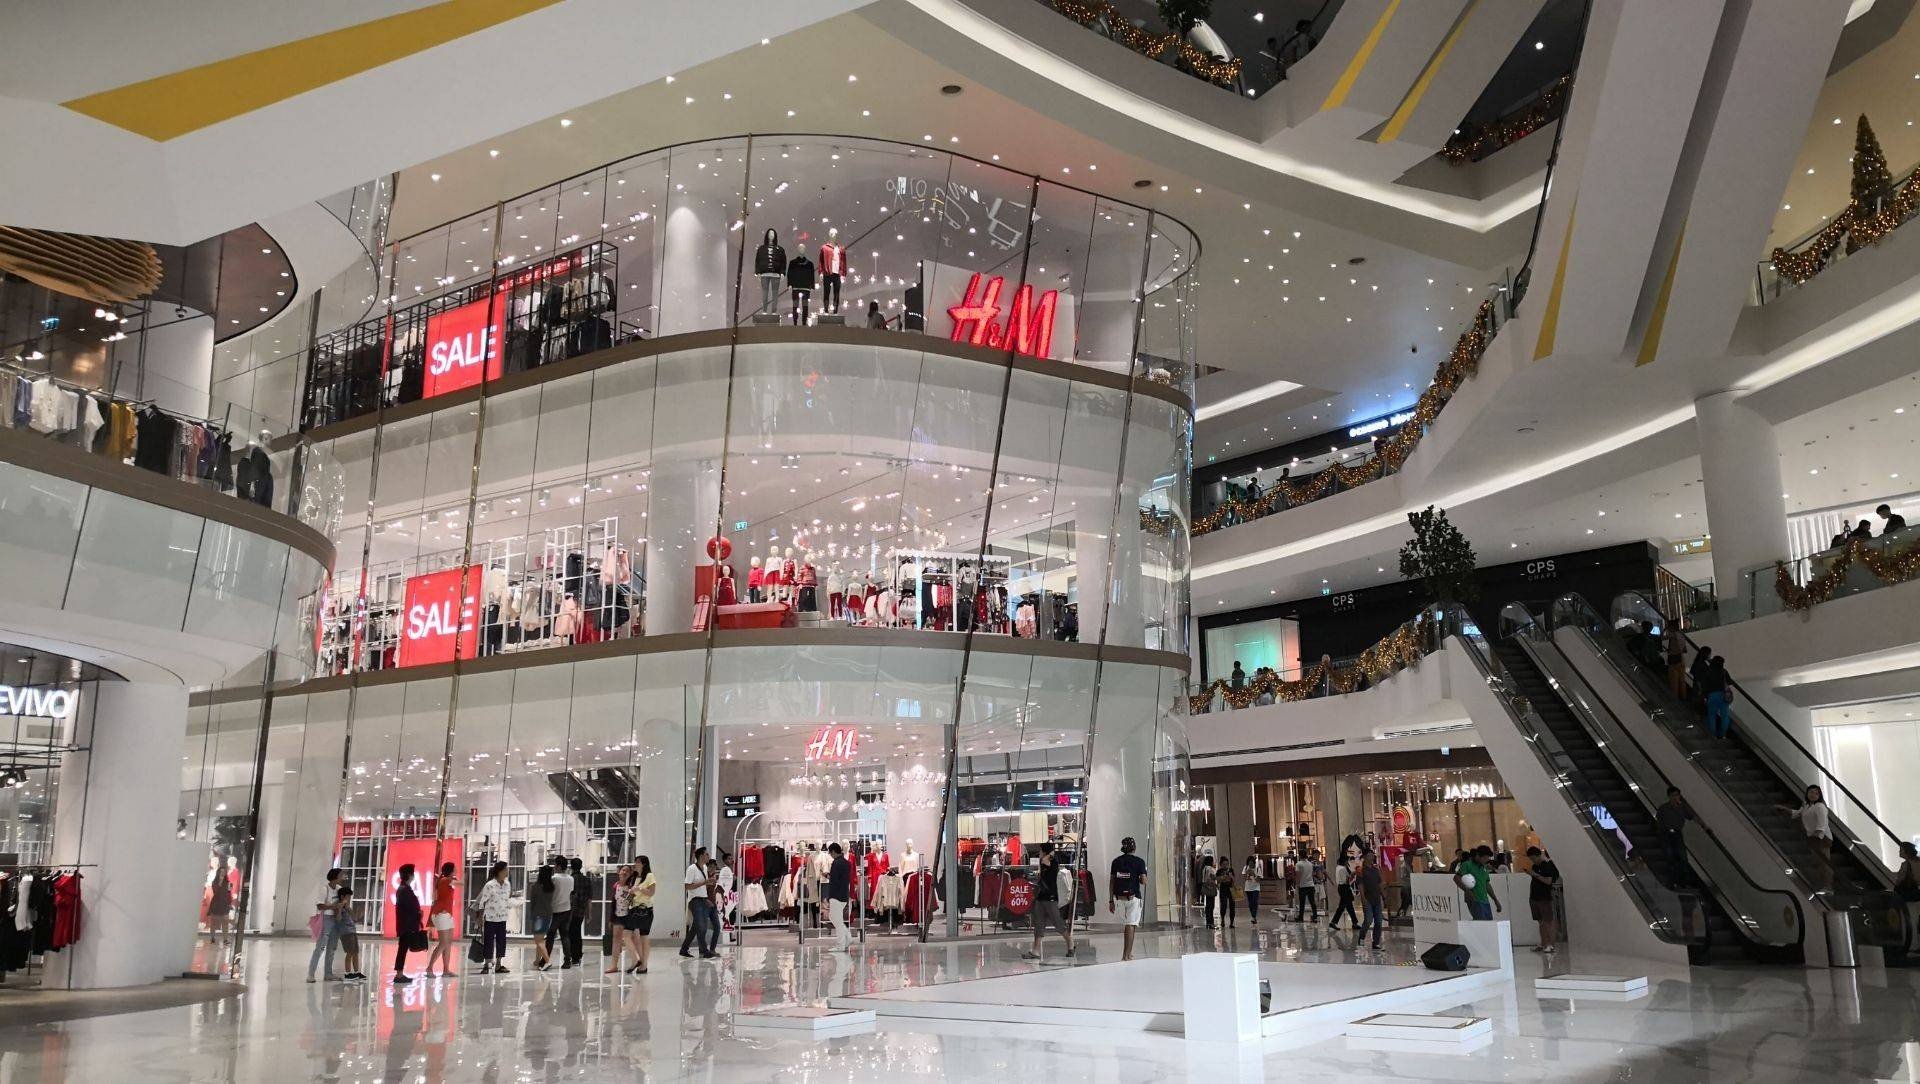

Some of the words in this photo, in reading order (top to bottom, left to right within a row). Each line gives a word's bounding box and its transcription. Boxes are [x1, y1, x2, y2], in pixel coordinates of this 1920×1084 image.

[947, 272, 1057, 359] H&M
[430, 324, 498, 375] SALE
[1527, 560, 1555, 574] CPS
[1332, 593, 1354, 607] CPS
[407, 596, 475, 640] SALE
[1444, 783, 1497, 800] JASPAL
[1009, 885, 1030, 894] SALE
[1011, 897, 1029, 907] 60%
